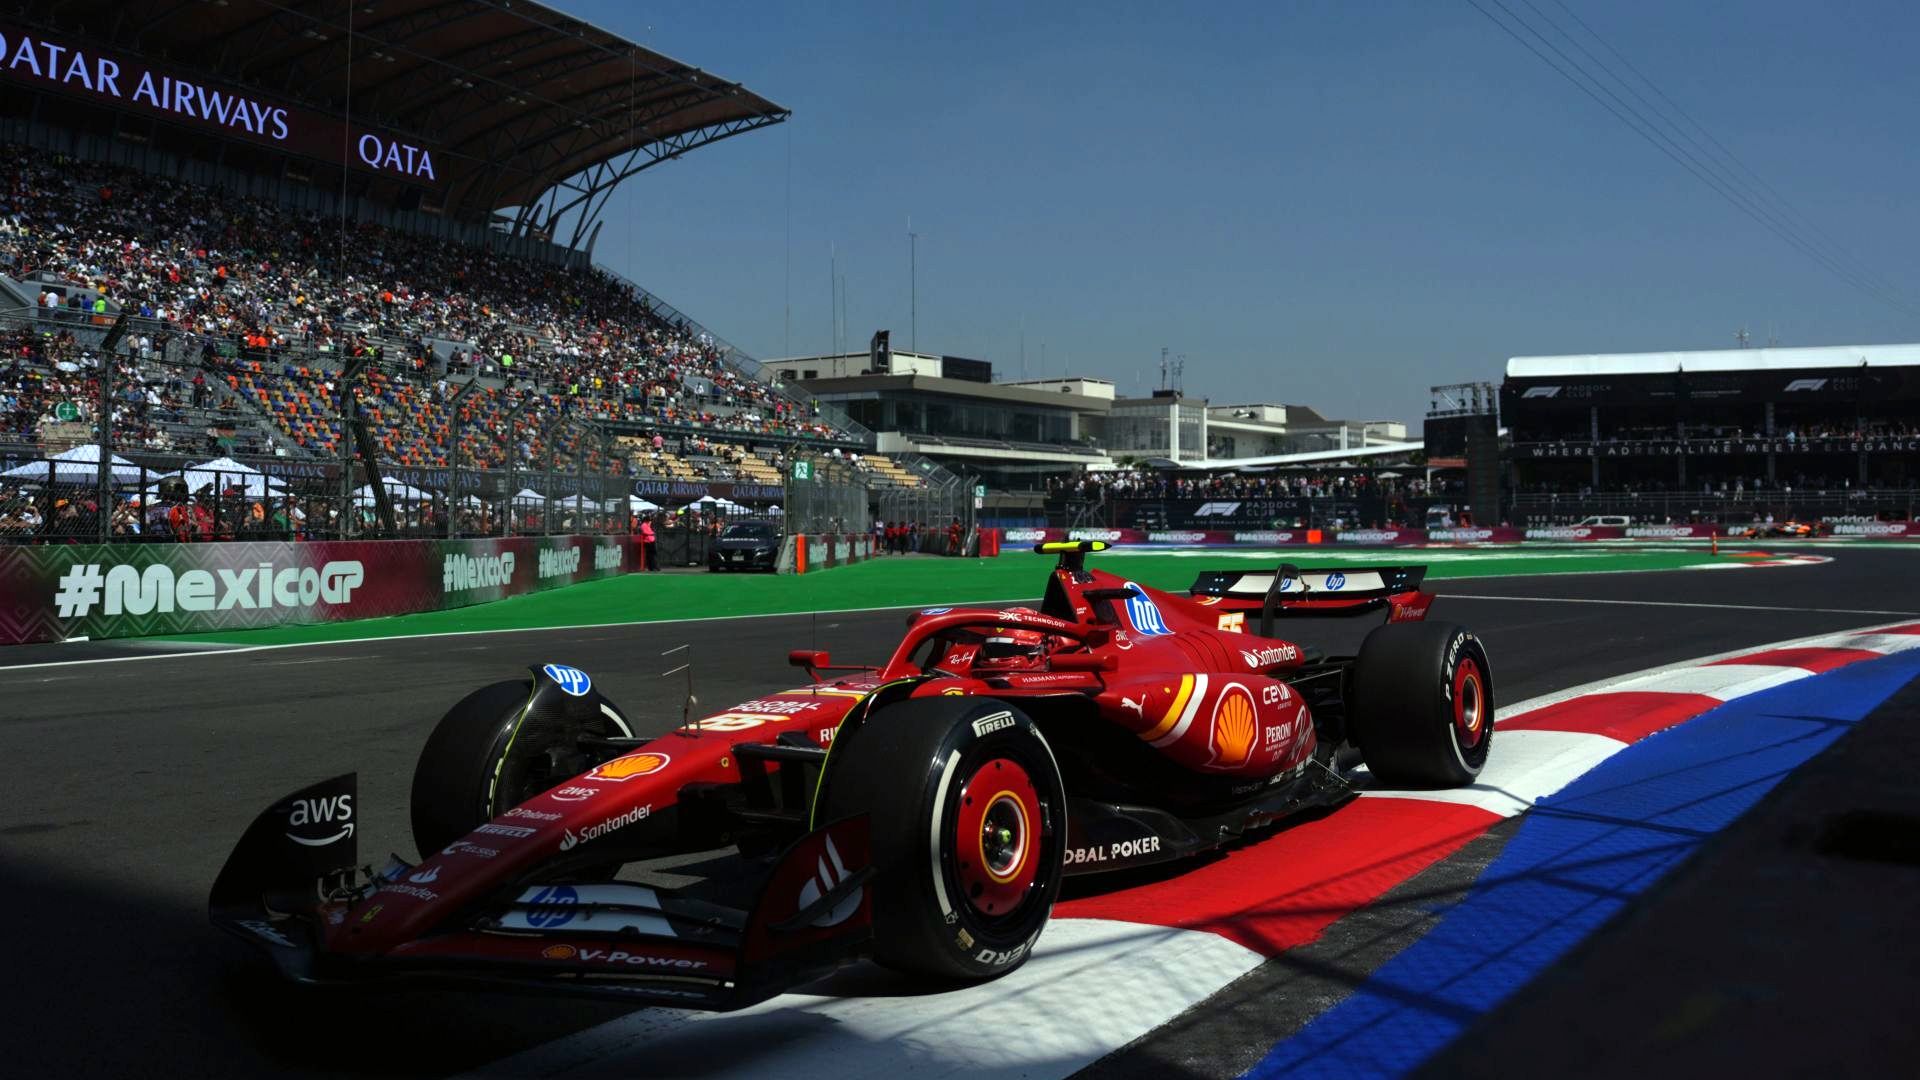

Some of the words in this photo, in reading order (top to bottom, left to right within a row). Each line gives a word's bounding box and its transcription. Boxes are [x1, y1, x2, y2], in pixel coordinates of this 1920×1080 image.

[132, 70, 289, 140] AIRWAYS
[358, 133, 435, 181] QATA
[1532, 446, 1595, 456] WHERE
[1607, 443, 1732, 456] ADRENALINE
[1745, 443, 1810, 452] MEETS
[635, 481, 669, 495] QATAR
[671, 482, 710, 496] AIRWAYS
[731, 485, 760, 498] QATAR
[1336, 530, 1399, 542] #MexicoGP
[1429, 529, 1493, 540] #MexicoGP
[1525, 528, 1592, 538] #MexicoGP
[1625, 527, 1693, 538] #MexicoGP
[1833, 524, 1907, 535] #MexicoGP
[1148, 533, 1207, 542] #MexicoGP
[538, 545, 581, 579] #MexicoGP
[442, 551, 515, 593] #MexicoGP
[55, 560, 364, 618] #MexicoGP
[1023, 615, 1066, 628] TECHNOLOGY
[1217, 611, 1245, 634] 55
[1258, 644, 1297, 667] Santander
[1021, 675, 1057, 683] HARMAN
[746, 700, 822, 711] GLOBAL
[971, 710, 1016, 738] PIRELLI
[1265, 721, 1292, 745] PERONI
[558, 786, 601, 797] aws
[289, 794, 353, 826] aws
[472, 823, 537, 838] PIRELLI
[579, 803, 653, 844] Santander
[1110, 836, 1161, 860] POKER
[578, 948, 709, 969] V-Power
